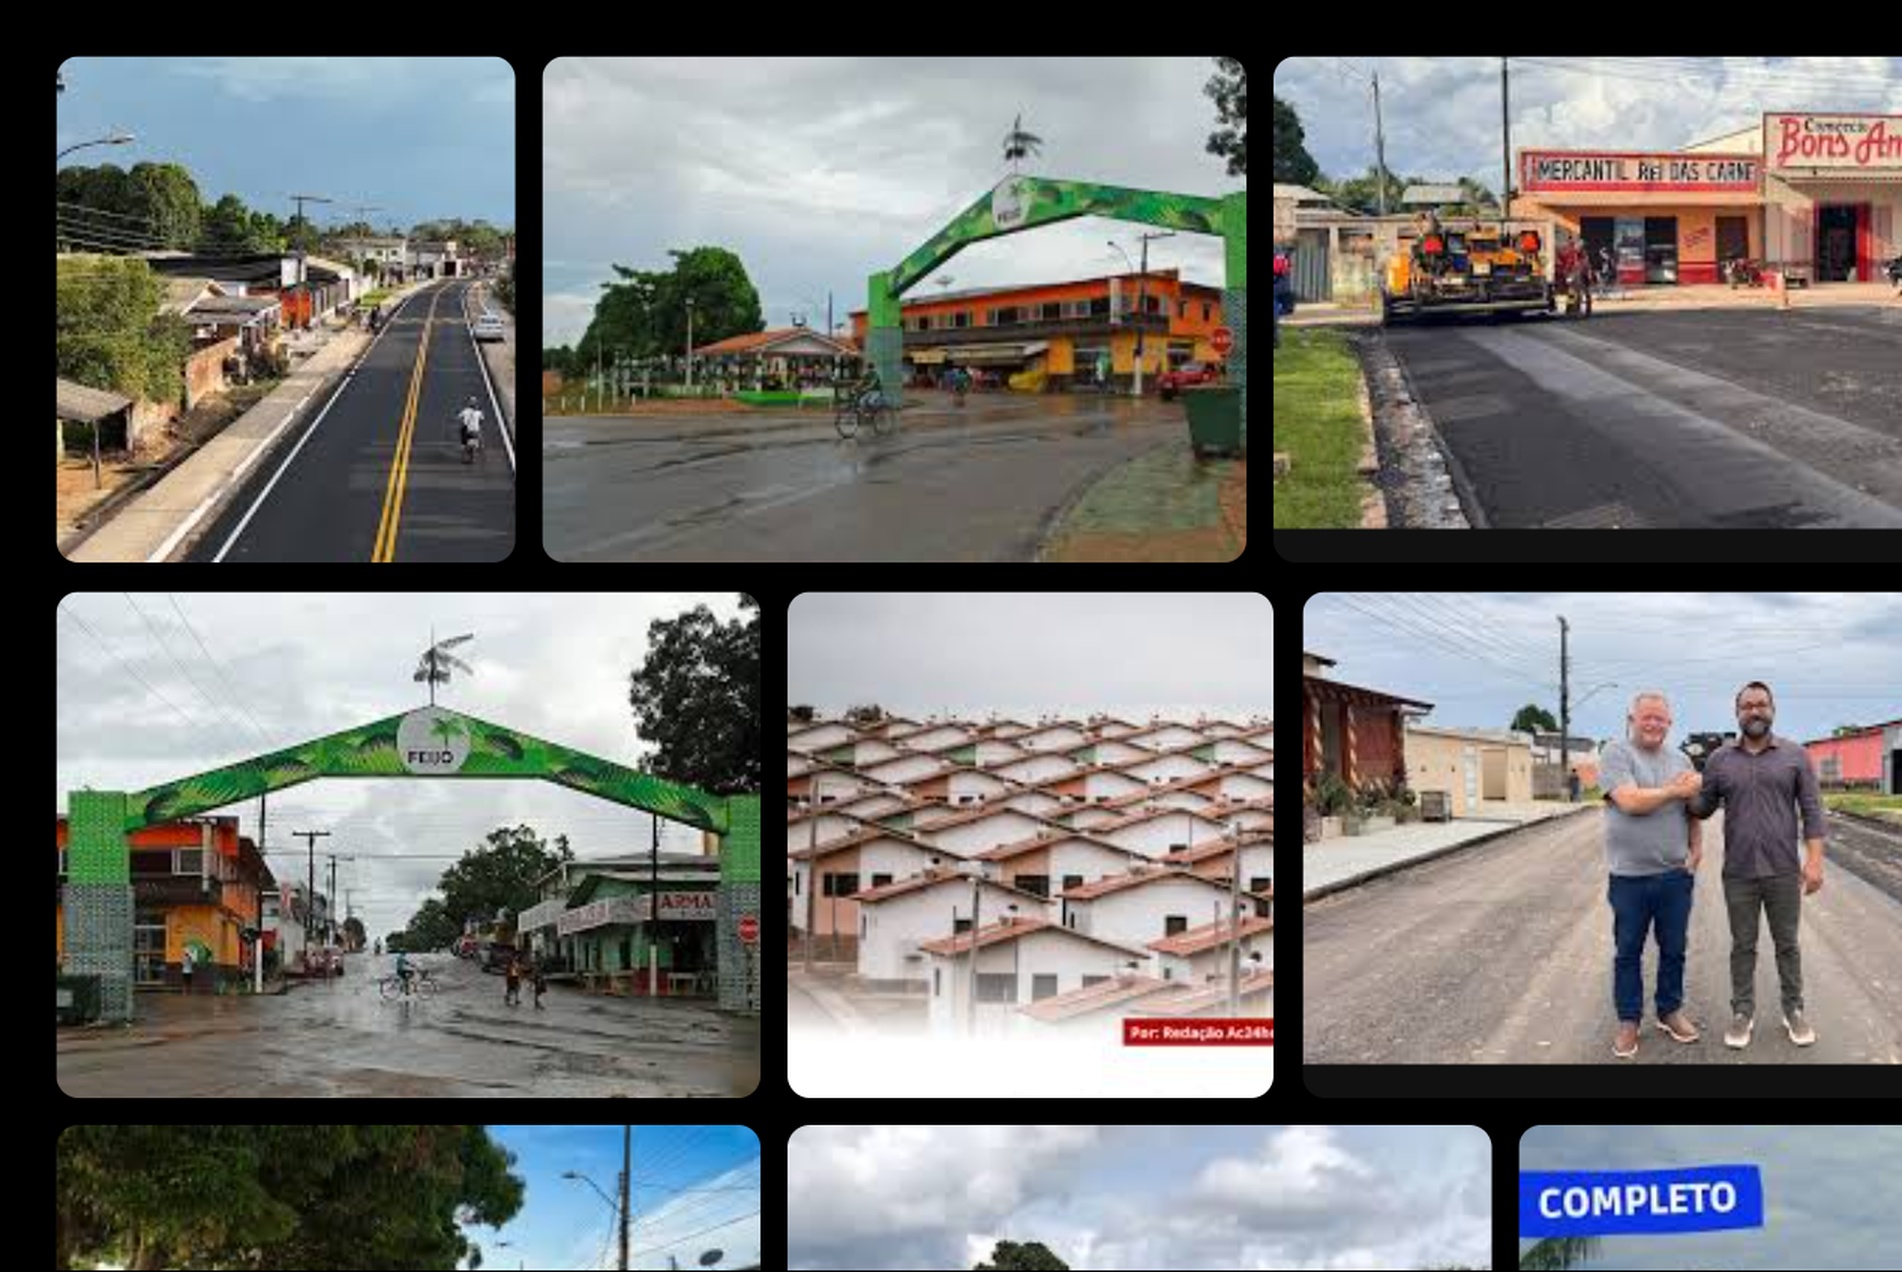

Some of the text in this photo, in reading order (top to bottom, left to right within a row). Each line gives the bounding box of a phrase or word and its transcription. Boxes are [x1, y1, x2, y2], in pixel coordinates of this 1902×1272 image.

[1777, 117, 1849, 169] Bons
[1538, 159, 1628, 181] MERCANTIL
[1669, 162, 1699, 181] DAS
